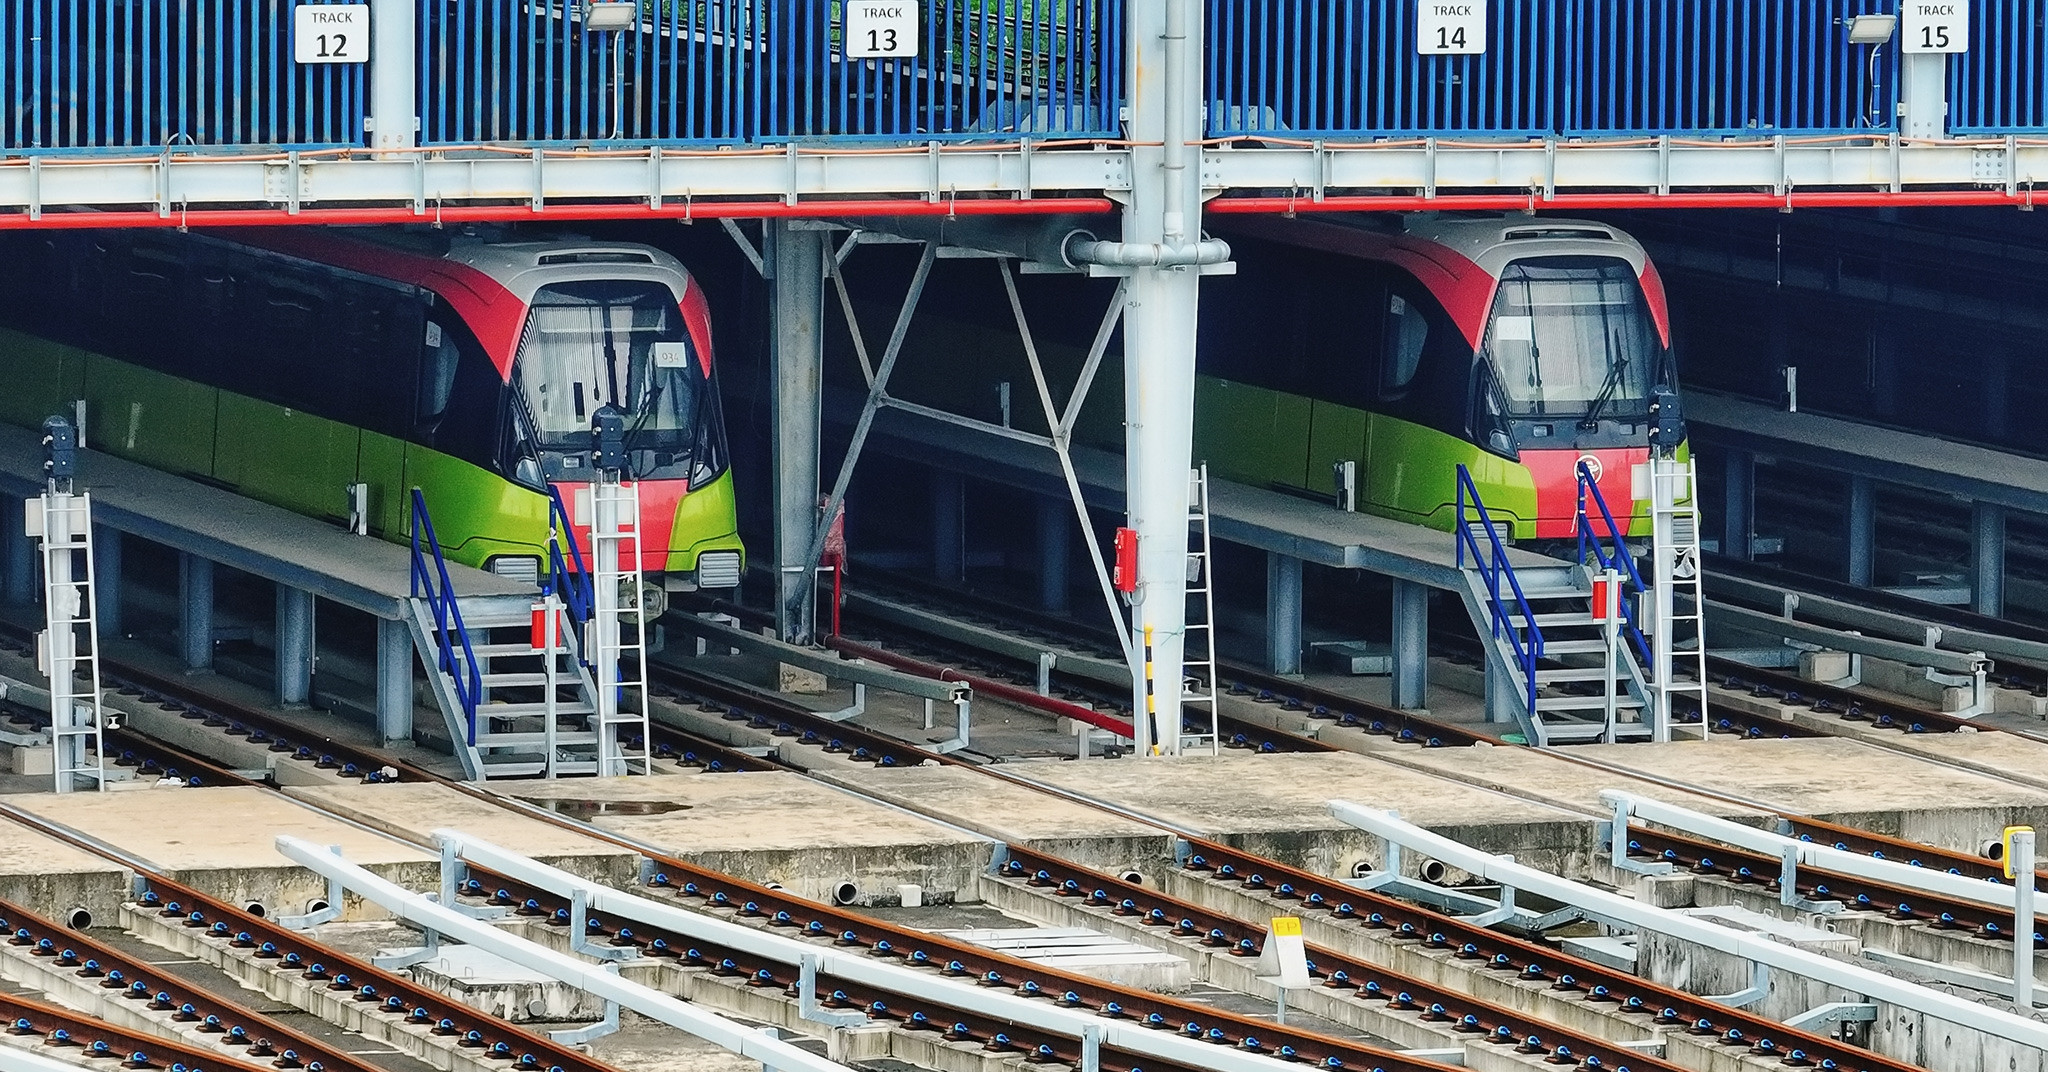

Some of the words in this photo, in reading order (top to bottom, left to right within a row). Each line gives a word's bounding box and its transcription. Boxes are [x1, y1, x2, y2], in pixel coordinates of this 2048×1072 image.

[312, 12, 353, 23] TRACK
[862, 7, 902, 18] TRACK
[1433, 5, 1471, 16] TRACK
[1917, 5, 1954, 16] TRACK
[316, 33, 347, 57] 12
[867, 28, 897, 52] 13
[1437, 26, 1466, 49] 14
[1921, 25, 1949, 48] 15
